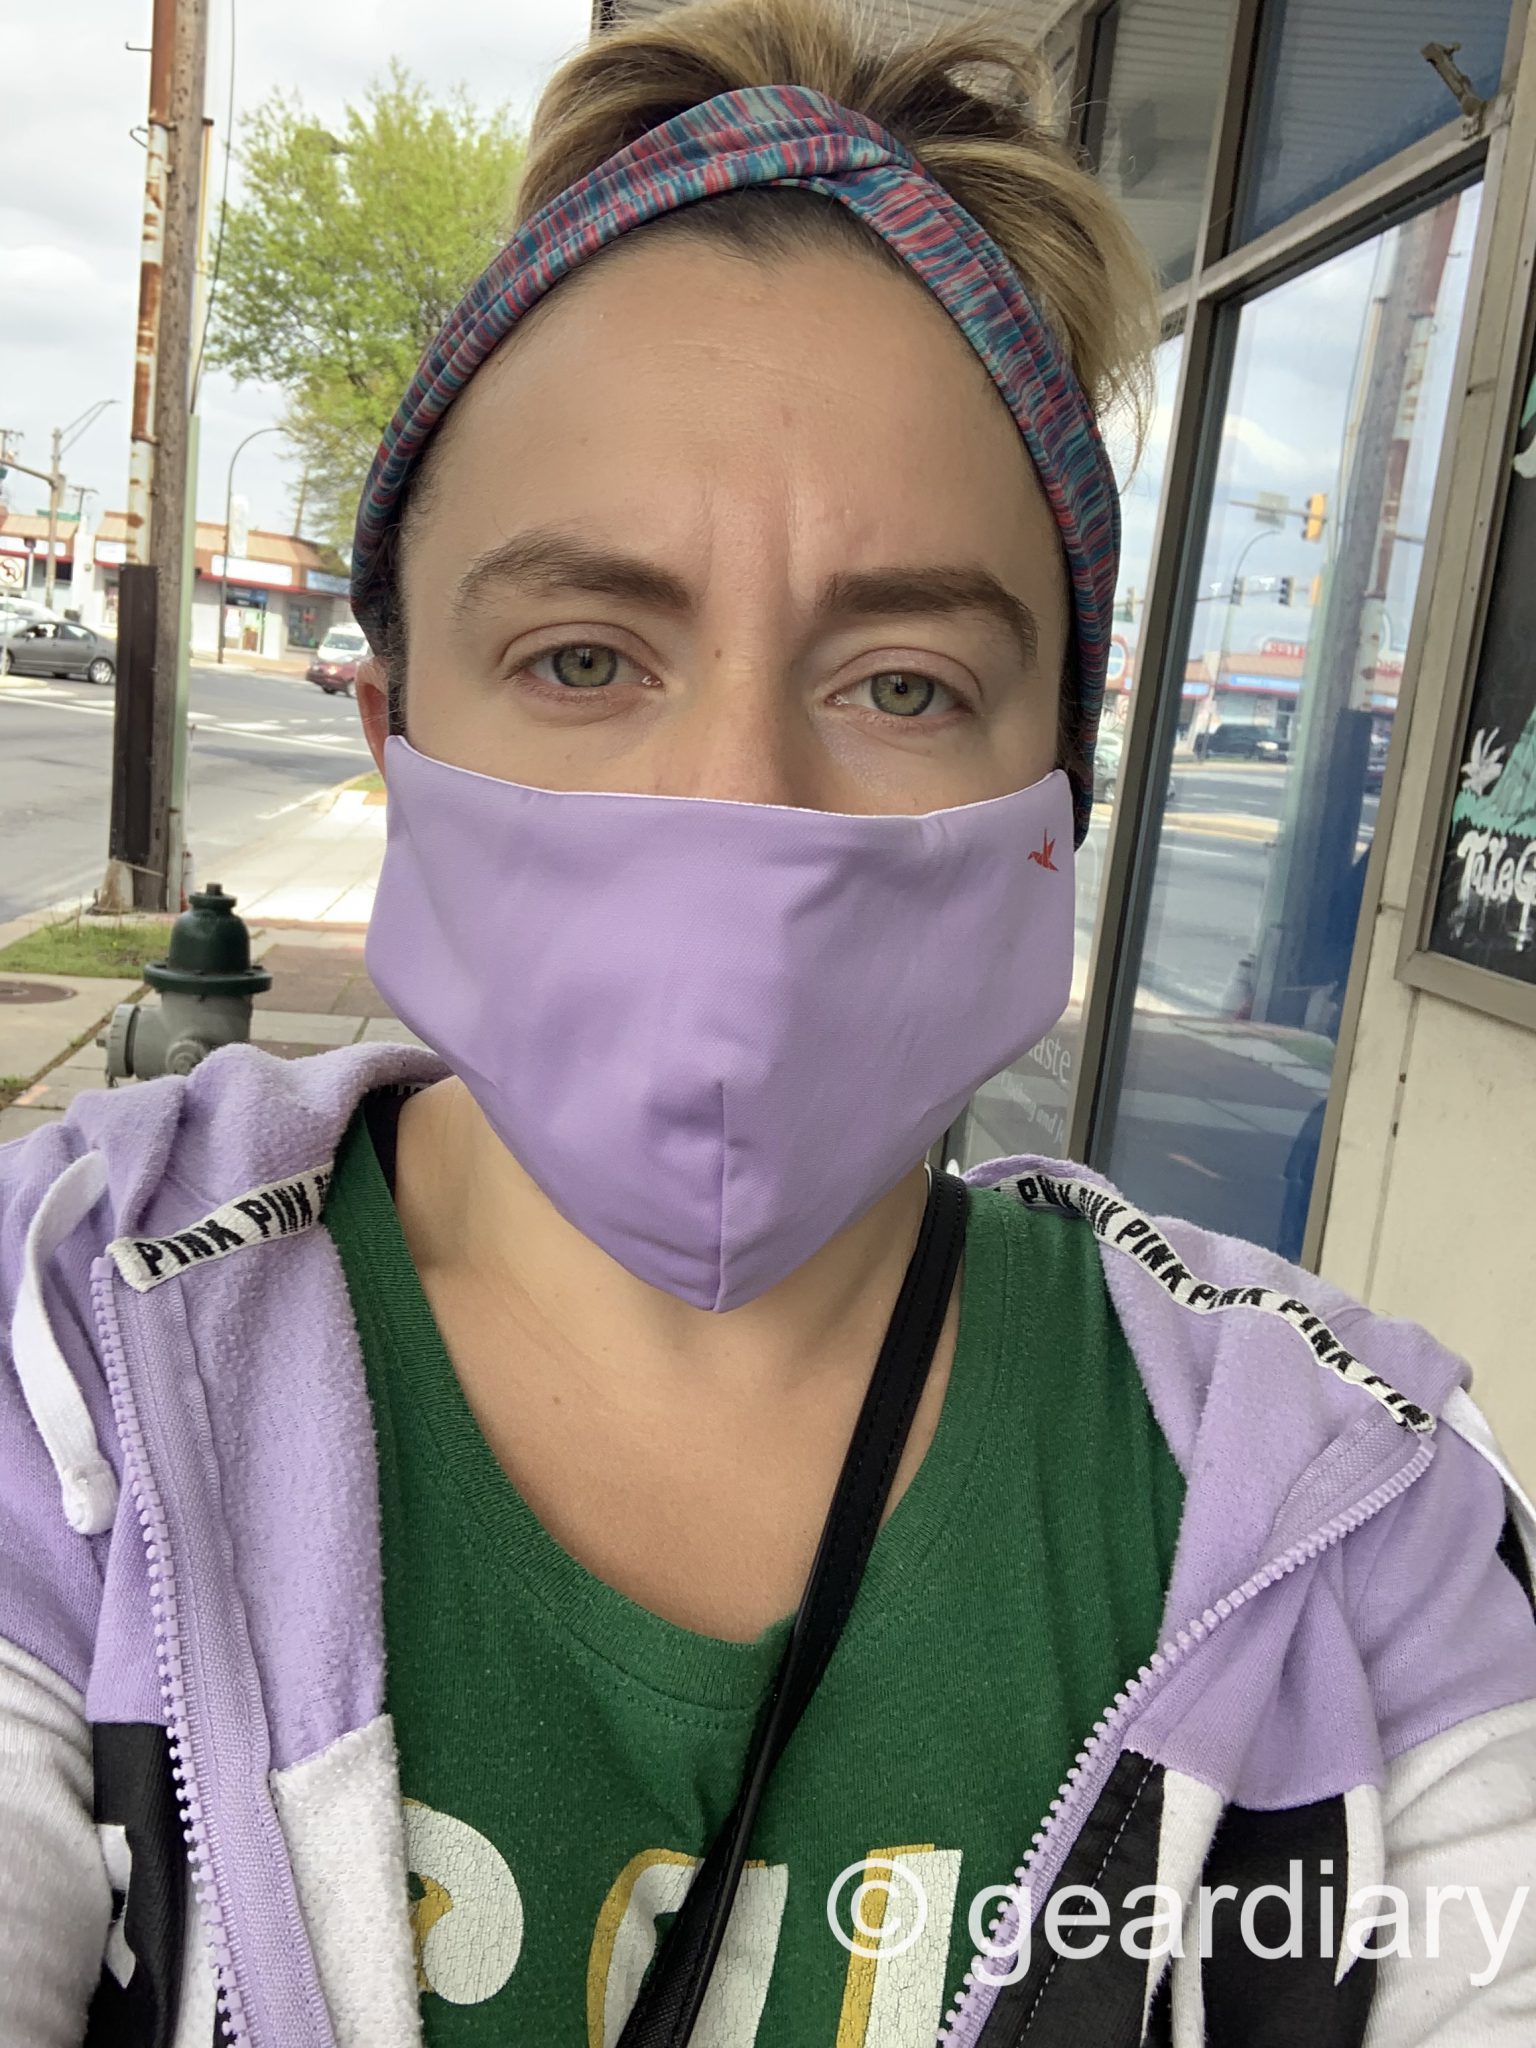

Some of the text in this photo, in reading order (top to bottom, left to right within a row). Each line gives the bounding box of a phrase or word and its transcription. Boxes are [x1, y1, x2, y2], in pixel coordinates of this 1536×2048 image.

[1029, 1036, 1072, 1084] aste
[134, 1219, 245, 1280] PINK
[234, 1182, 313, 1238] PINK
[1114, 1218, 1192, 1294] PINK
[1186, 1283, 1273, 1310] PINK
